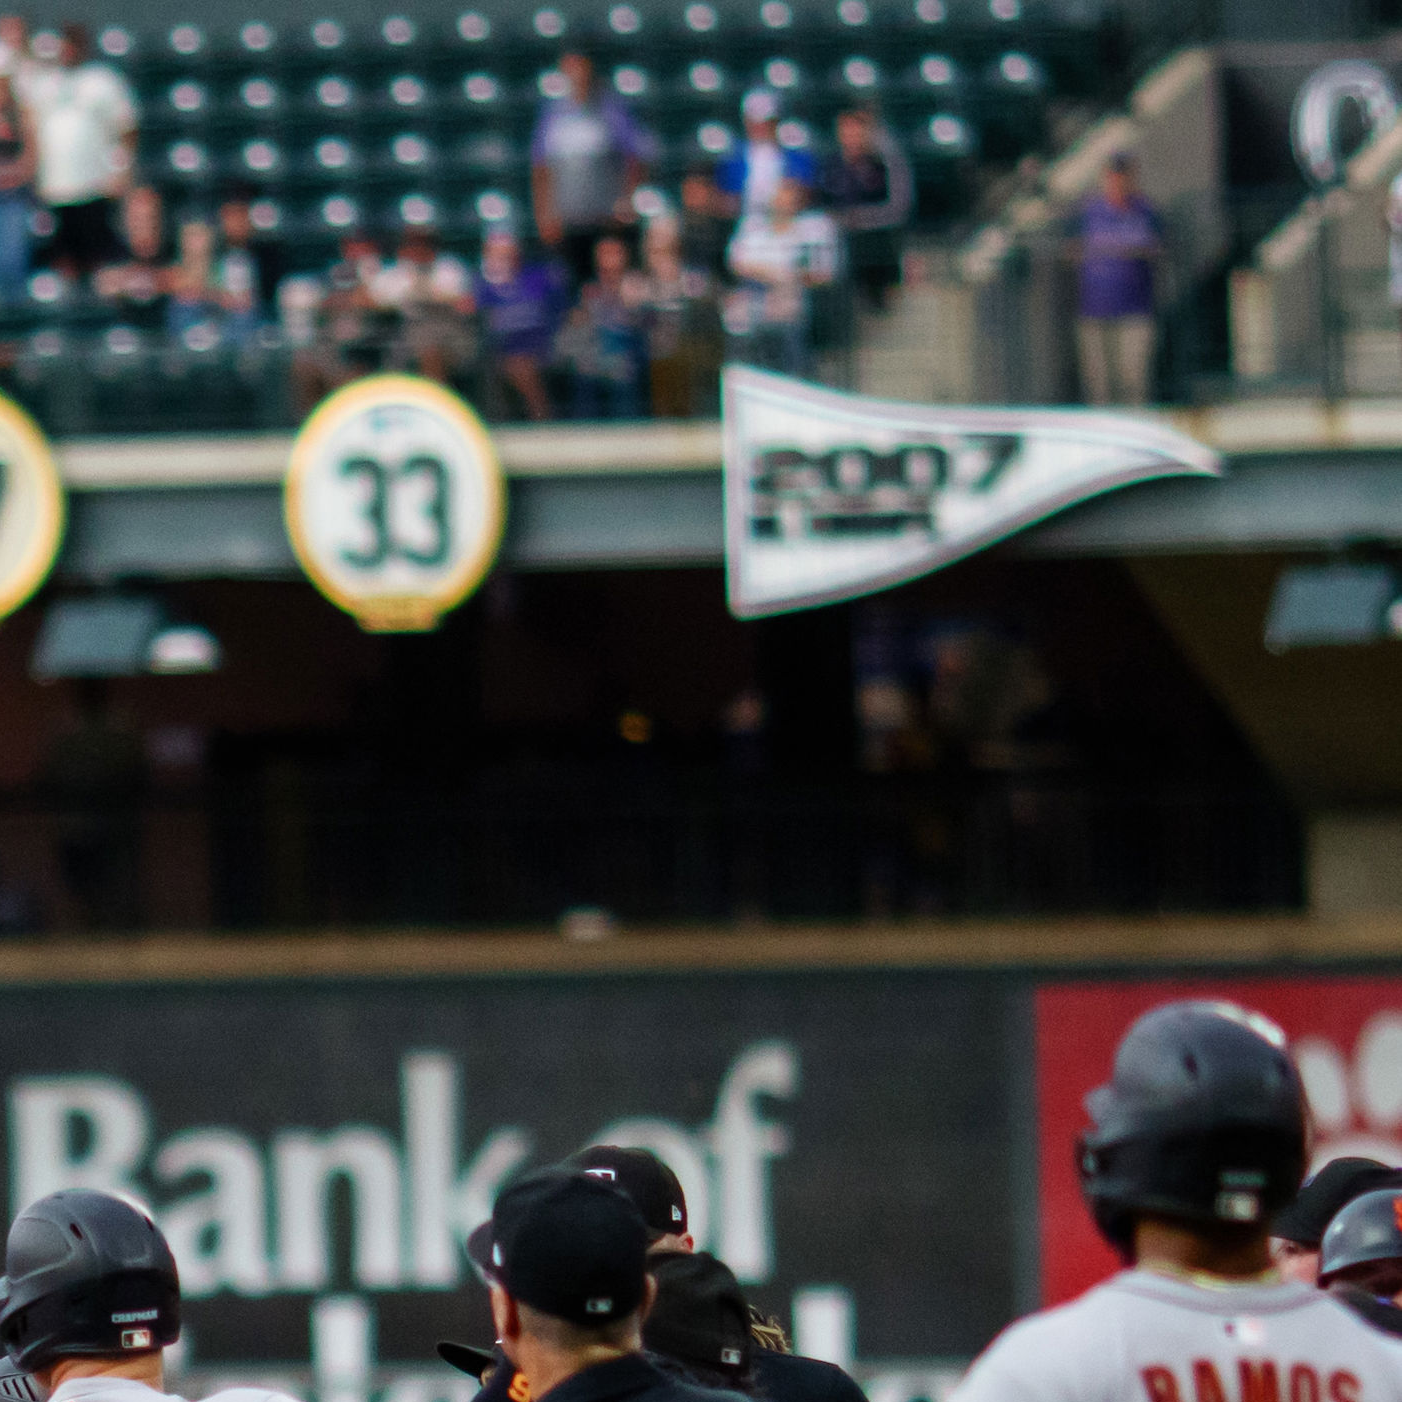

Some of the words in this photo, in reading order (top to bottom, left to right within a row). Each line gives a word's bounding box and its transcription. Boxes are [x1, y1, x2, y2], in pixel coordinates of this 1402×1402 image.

[750, 433, 1025, 497] 2007
[338, 454, 451, 569] 33
[9, 1048, 529, 1294] Bank
[112, 1309, 159, 1324] CHAPMAN
